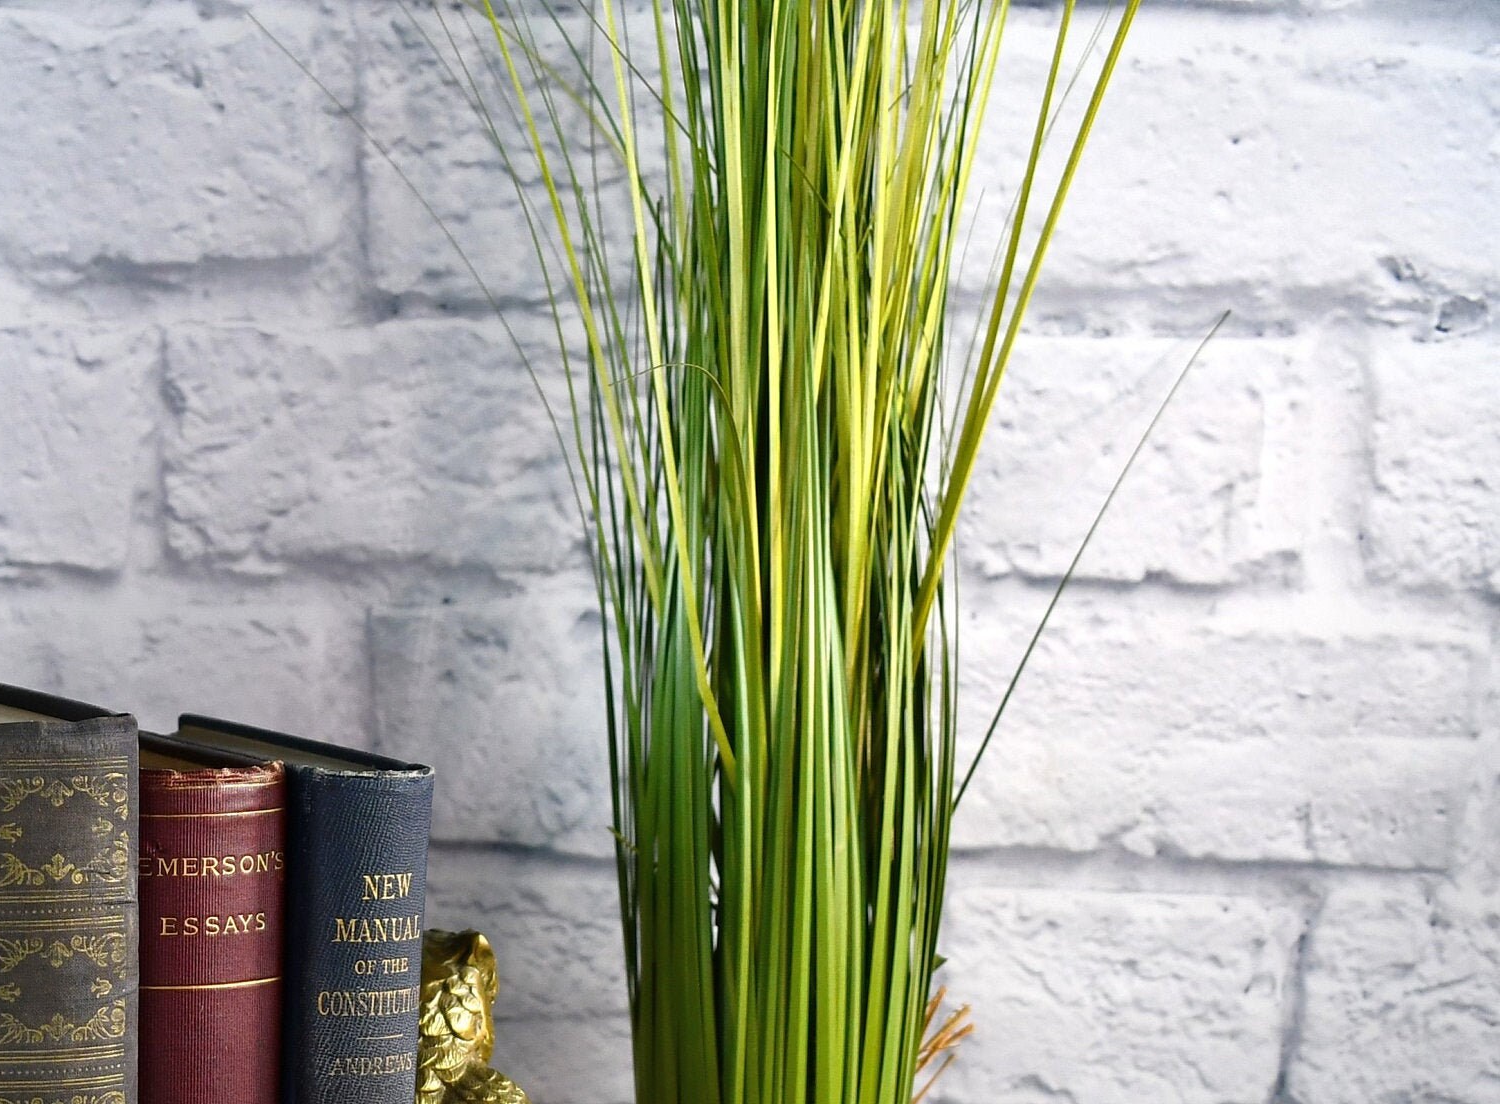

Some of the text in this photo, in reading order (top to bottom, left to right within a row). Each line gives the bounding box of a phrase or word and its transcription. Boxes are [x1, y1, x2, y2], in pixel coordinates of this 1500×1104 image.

[138, 851, 285, 877] EMERSON'S
[362, 873, 412, 900] NEW
[160, 912, 266, 937] ESSAYS
[331, 914, 420, 943] MANUAL
[355, 957, 409, 974] OF THE
[328, 1052, 413, 1077] ANDREWS
